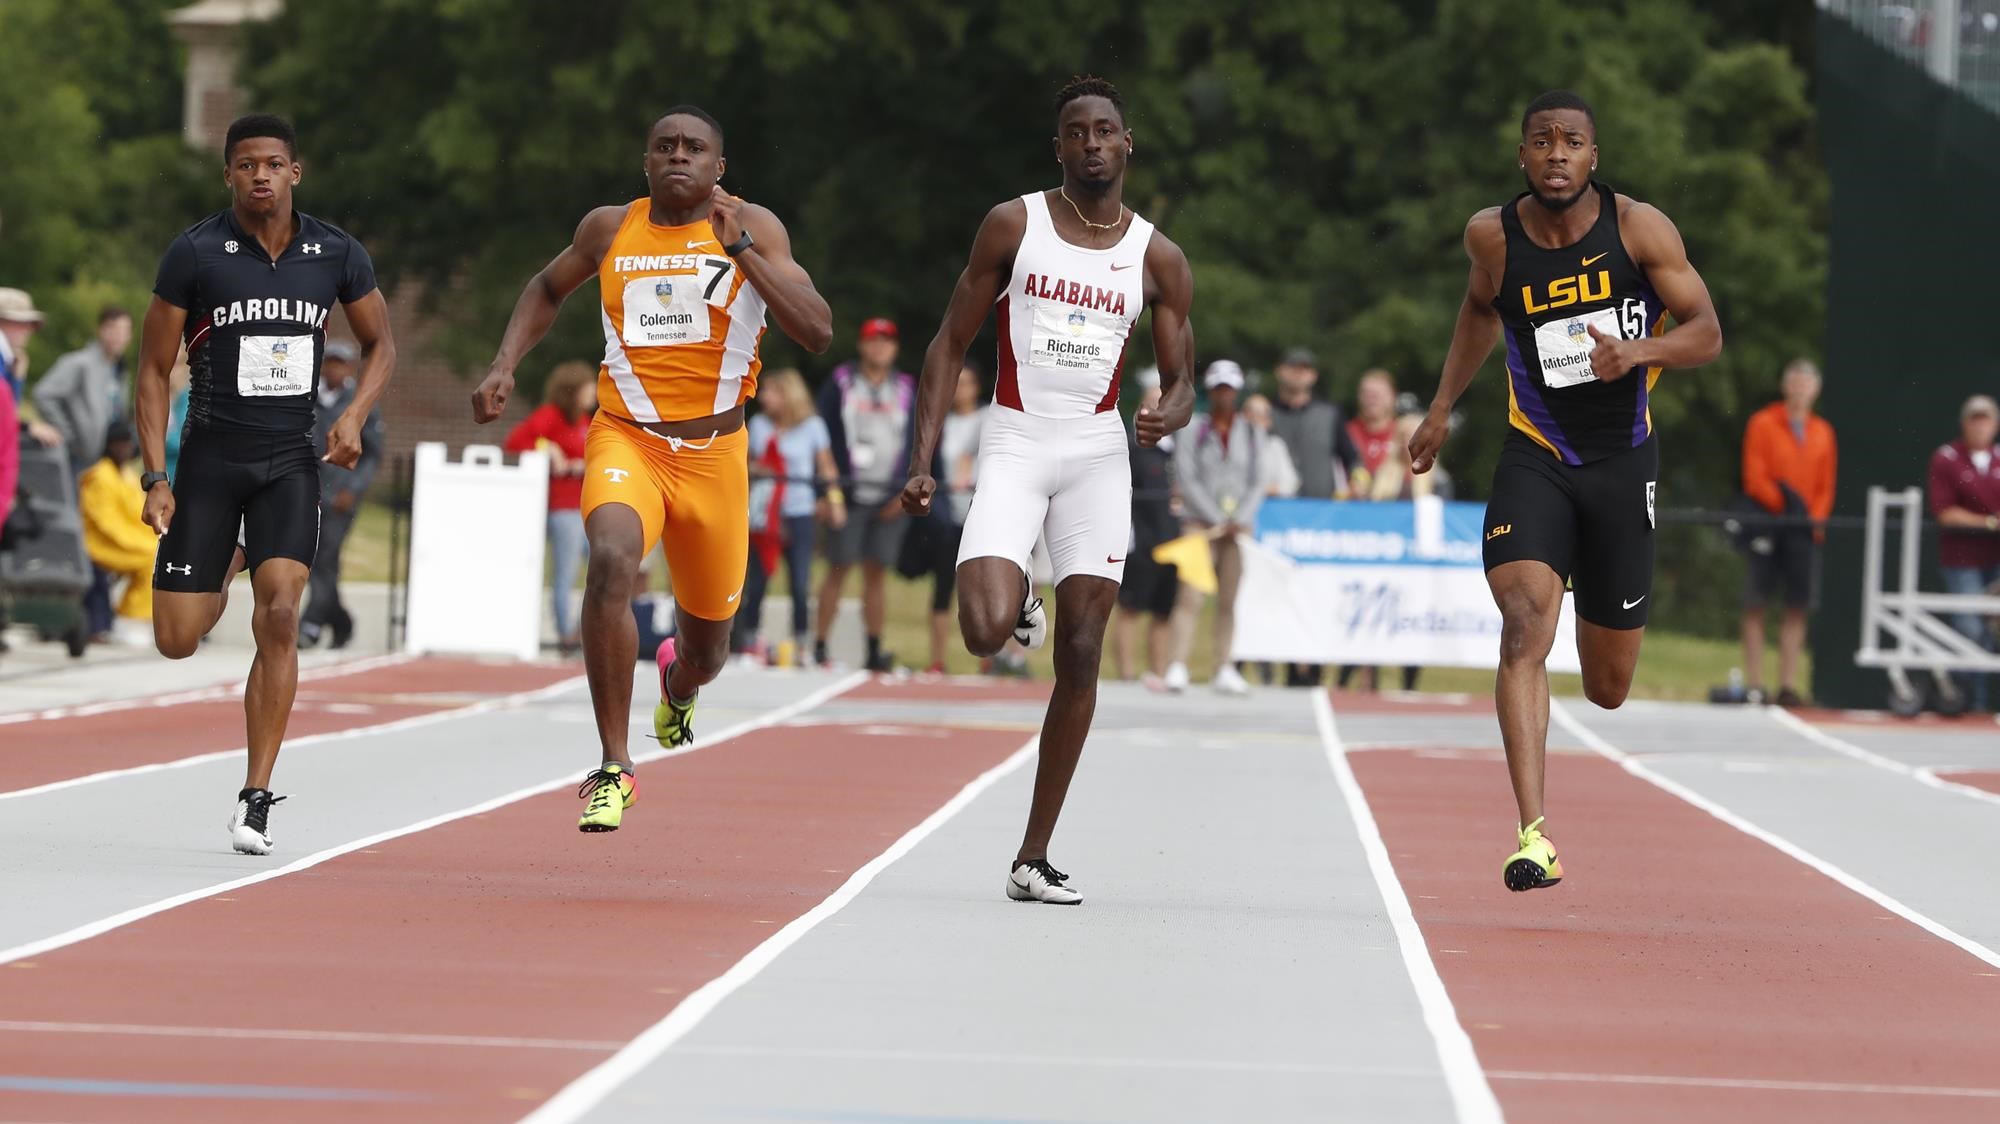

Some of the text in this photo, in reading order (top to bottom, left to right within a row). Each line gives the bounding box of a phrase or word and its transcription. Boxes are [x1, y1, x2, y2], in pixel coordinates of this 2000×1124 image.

[614, 254, 702, 273] TENNESS
[702, 258, 731, 300] 7
[1024, 273, 1126, 316] ALABAMA
[1522, 270, 1612, 315] LSU
[213, 297, 328, 329] CAROLINA
[639, 312, 693, 328] Coleman
[1627, 300, 1643, 340] 5
[647, 332, 687, 341] Tennessee
[1047, 338, 1101, 357] Richards
[1055, 358, 1090, 369] Alabama
[269, 367, 288, 379] Titi
[251, 383, 302, 392] South Carolina
[603, 467, 630, 483] T
[1486, 524, 1512, 541] LSU
